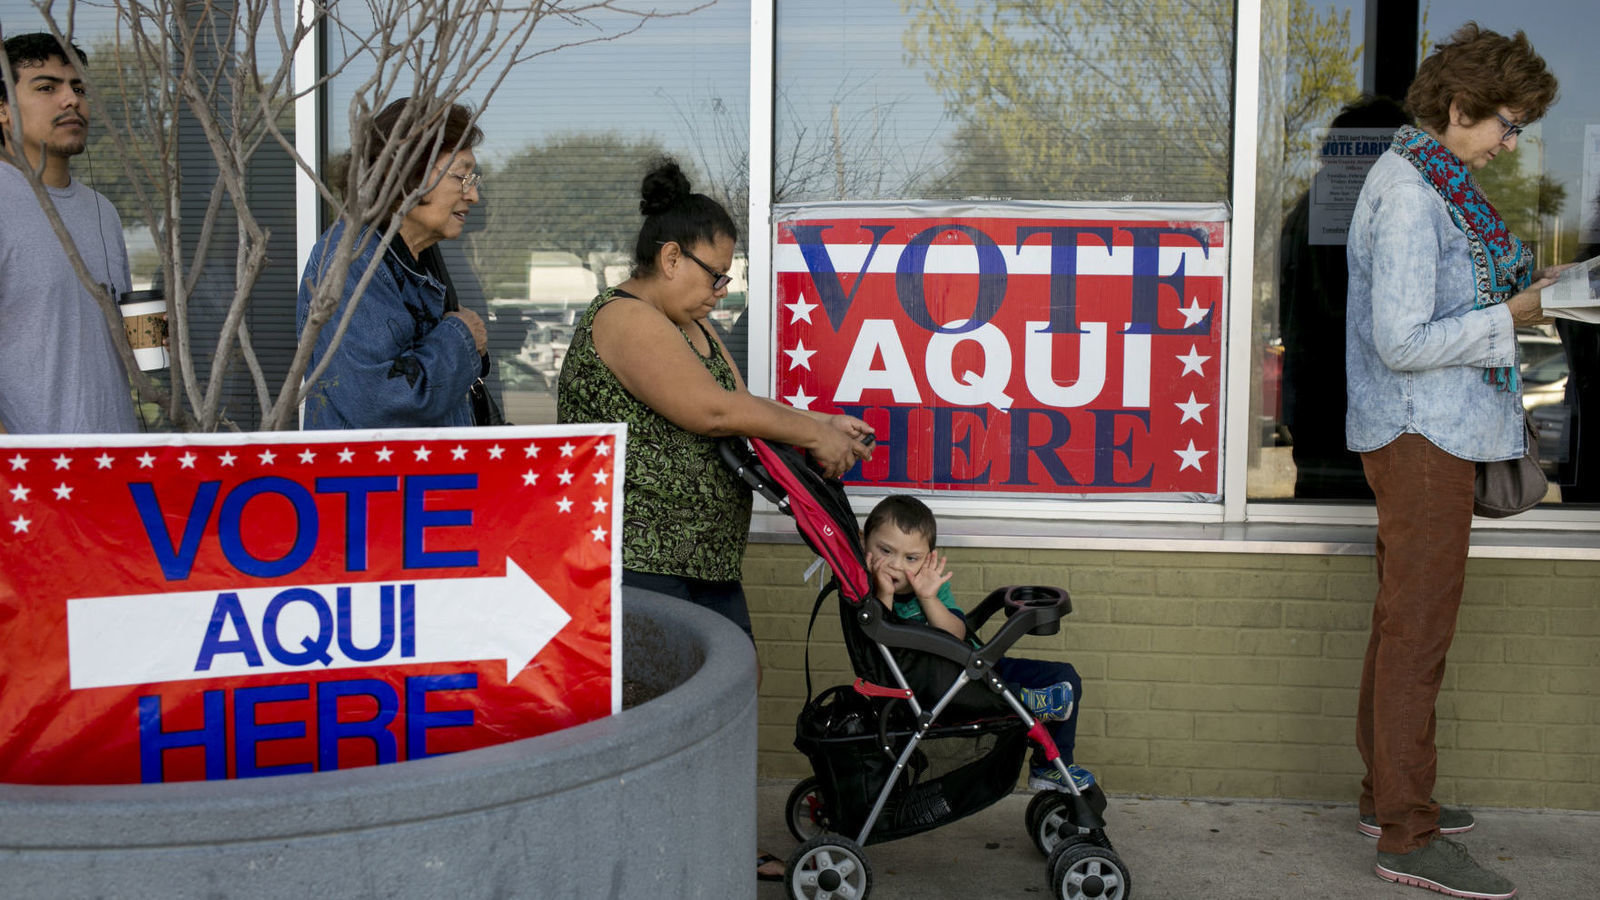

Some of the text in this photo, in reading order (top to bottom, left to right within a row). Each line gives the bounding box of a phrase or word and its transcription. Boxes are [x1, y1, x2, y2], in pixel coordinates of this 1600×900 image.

[1322, 141, 1391, 155] VOTE EARLY
[786, 224, 1215, 336] VOTE
[832, 319, 1152, 414] AQUI
[834, 405, 1154, 488] HERE
[128, 473, 479, 582] VOTE
[194, 584, 416, 672] AQUI
[138, 672, 478, 784] HERE
